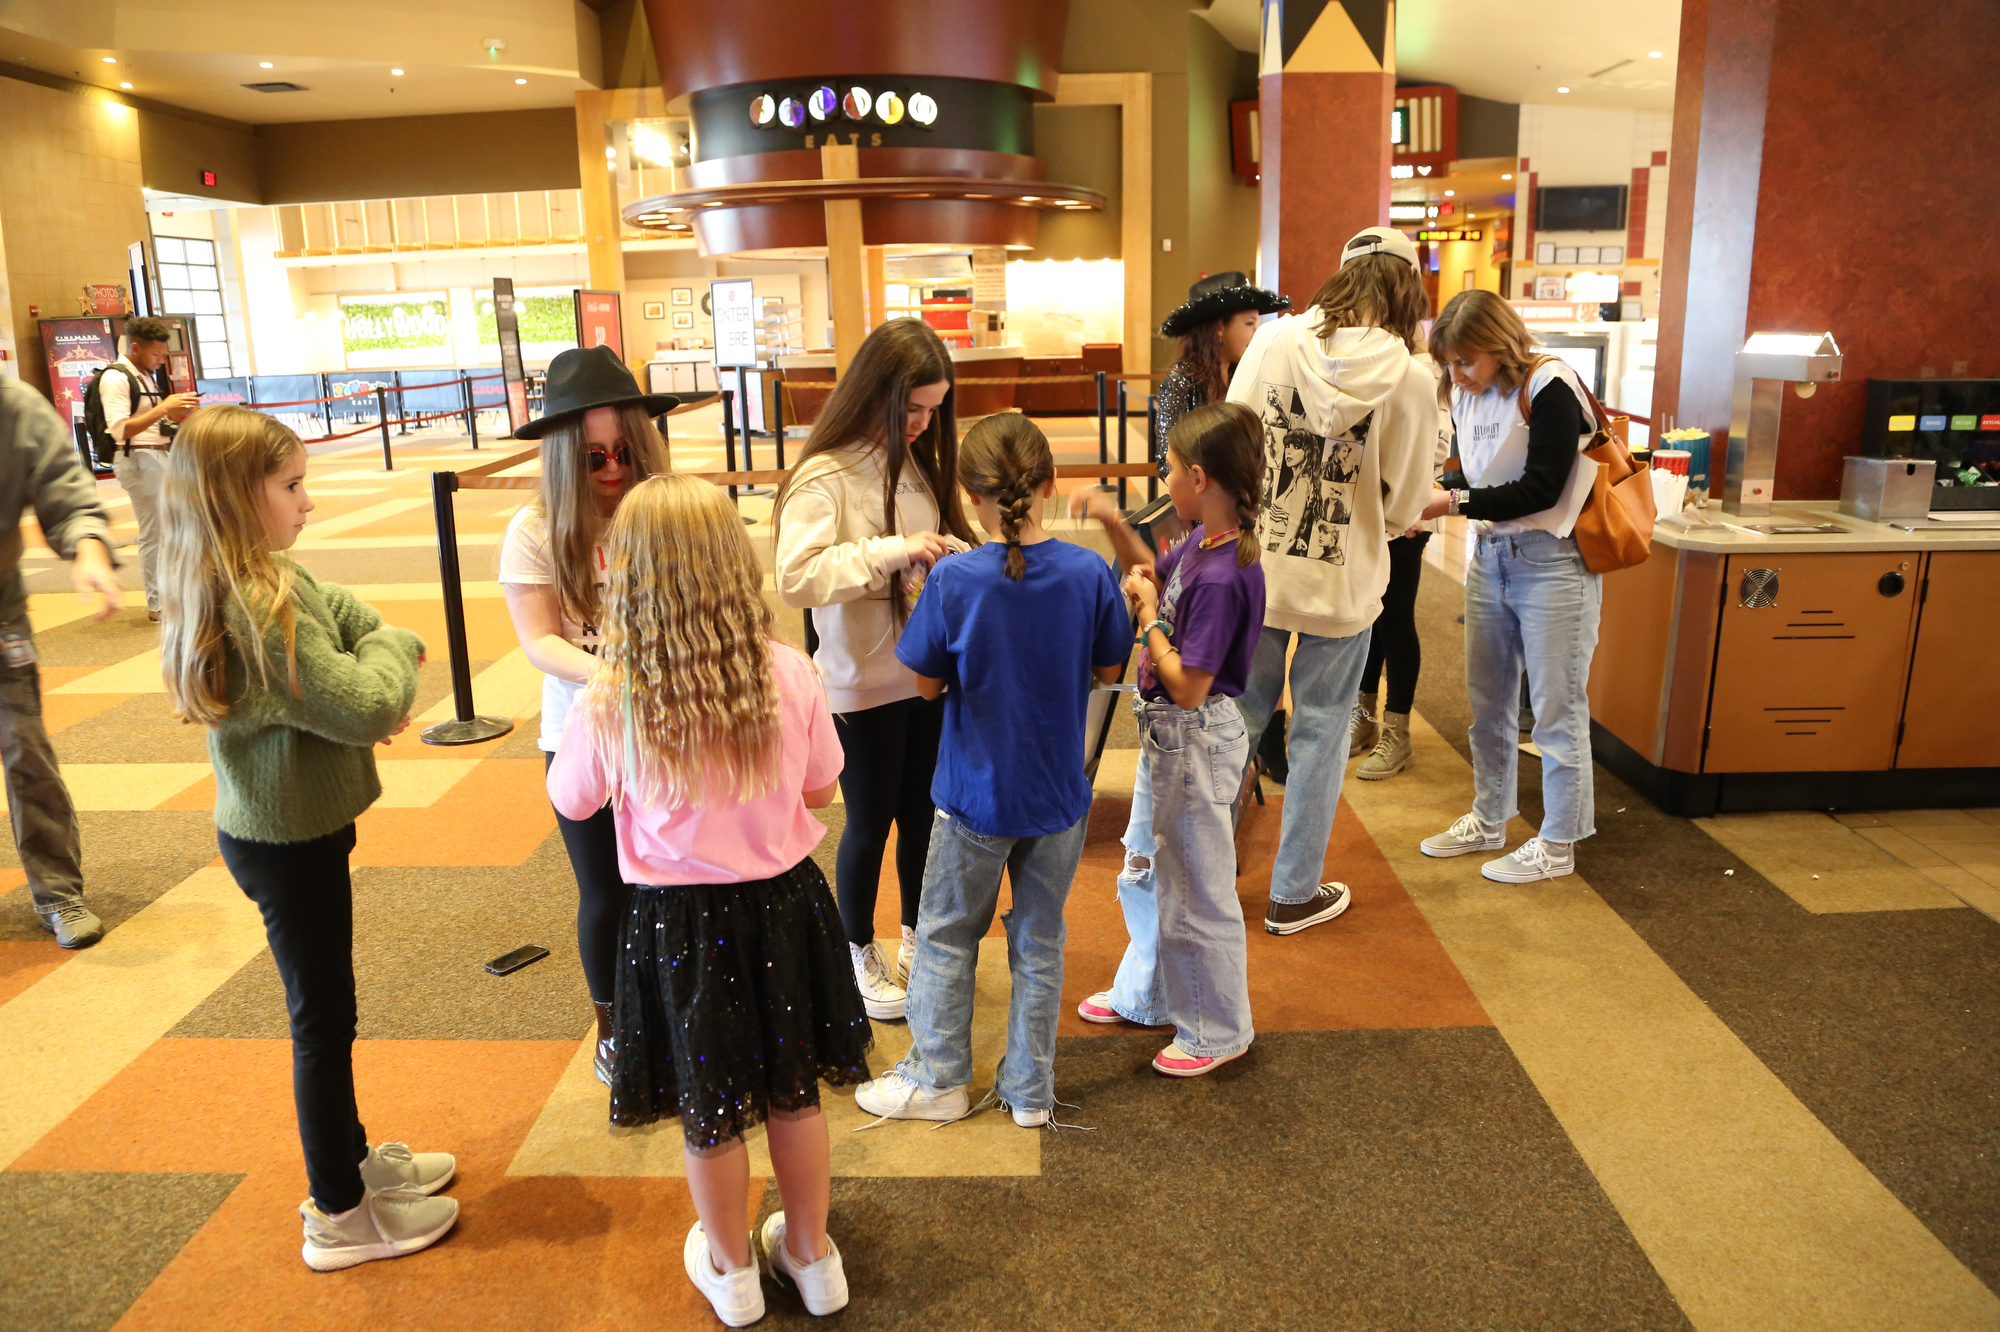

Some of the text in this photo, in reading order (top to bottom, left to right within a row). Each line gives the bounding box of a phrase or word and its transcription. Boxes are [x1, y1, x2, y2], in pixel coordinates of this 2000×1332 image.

[805, 133, 882, 148] EATS
[93, 287, 119, 298] PHOTOS
[716, 307, 751, 323] ENTER
[344, 313, 447, 339] HOLLYWOOD
